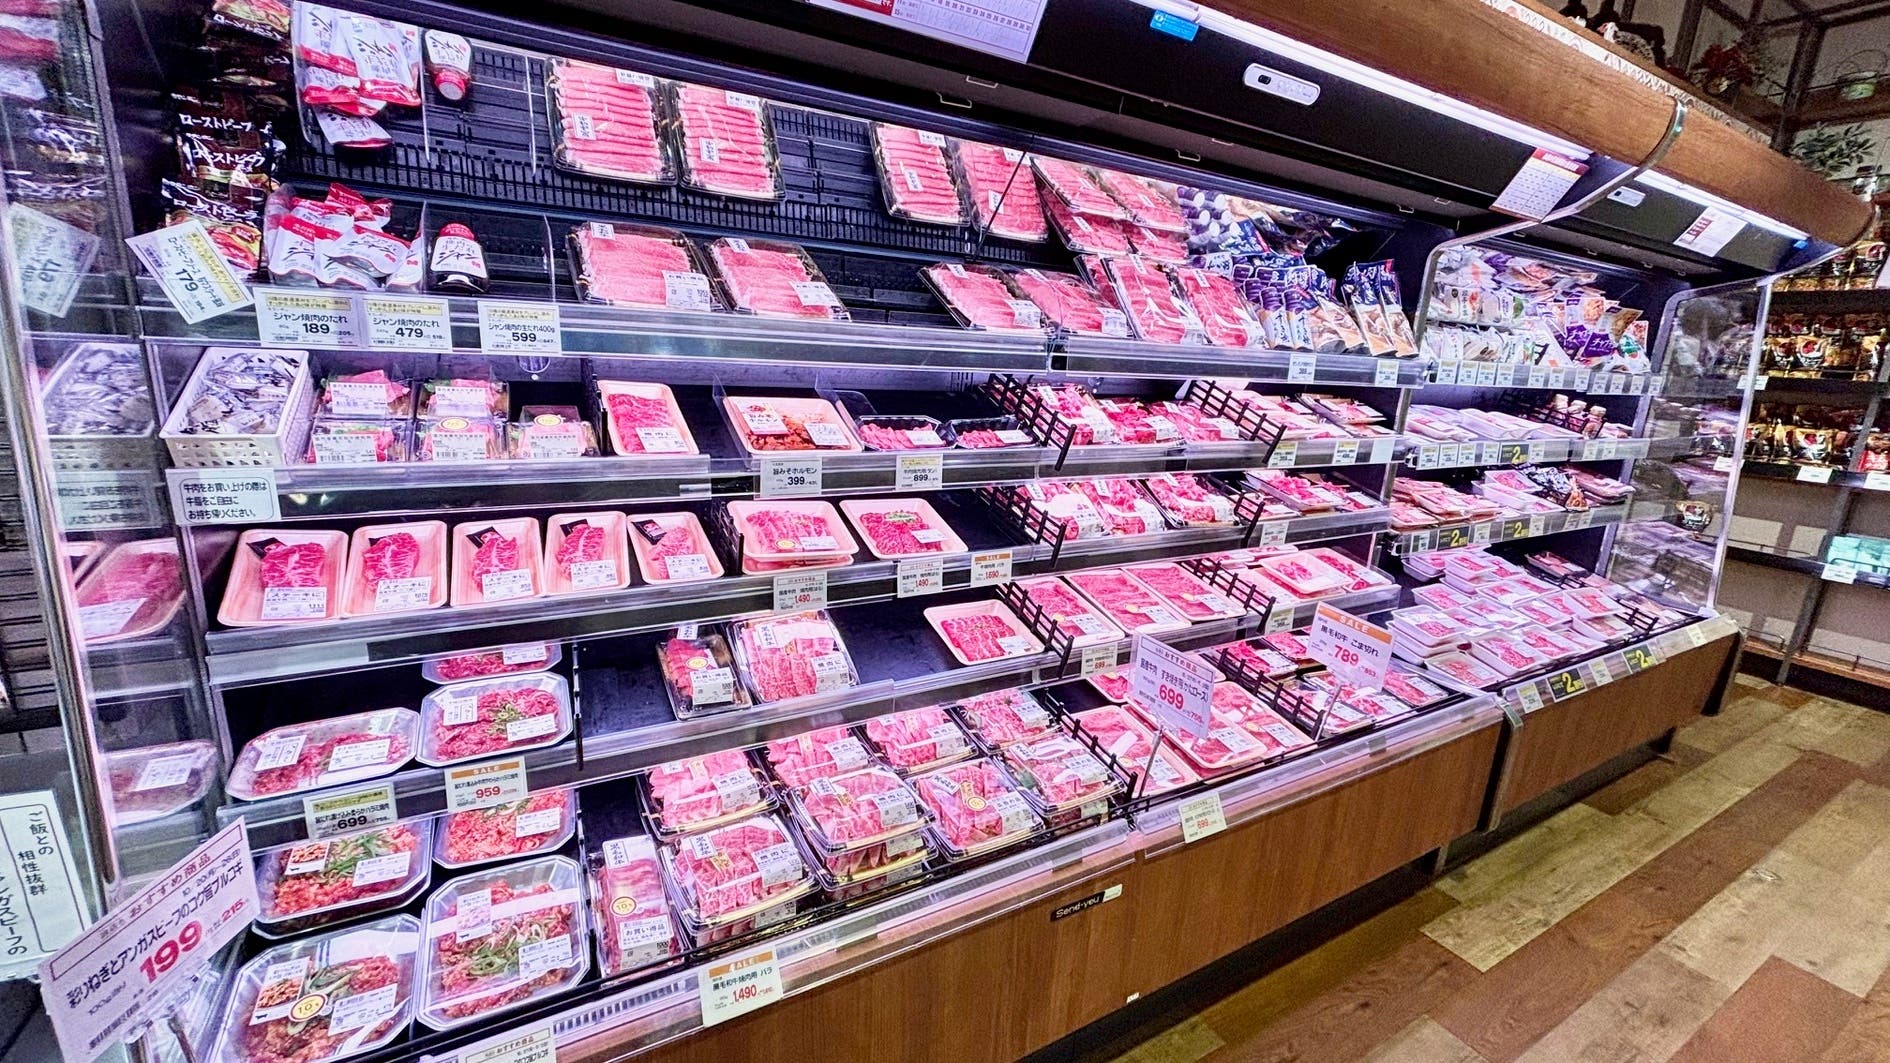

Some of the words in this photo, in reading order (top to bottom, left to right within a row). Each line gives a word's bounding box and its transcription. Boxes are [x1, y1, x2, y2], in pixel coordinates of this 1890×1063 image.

[176, 268, 199, 291] 179
[302, 323, 330, 334] 189
[396, 328, 423, 338] 479
[512, 332, 537, 342] 599
[788, 476, 805, 486] 399
[914, 474, 928, 482] 899
[1340, 616, 1369, 633] SALE
[1334, 645, 1359, 665] 789
[1159, 684, 1184, 710] 699
[473, 765, 500, 775] SALE
[476, 786, 500, 798] 959
[338, 815, 367, 829] 699
[29, 811, 54, 855] ご飯との
[18, 850, 48, 896] 相性抜群
[130, 852, 211, 920] おすすめ商品
[139, 920, 202, 984] 199
[222, 899, 244, 922] 215
